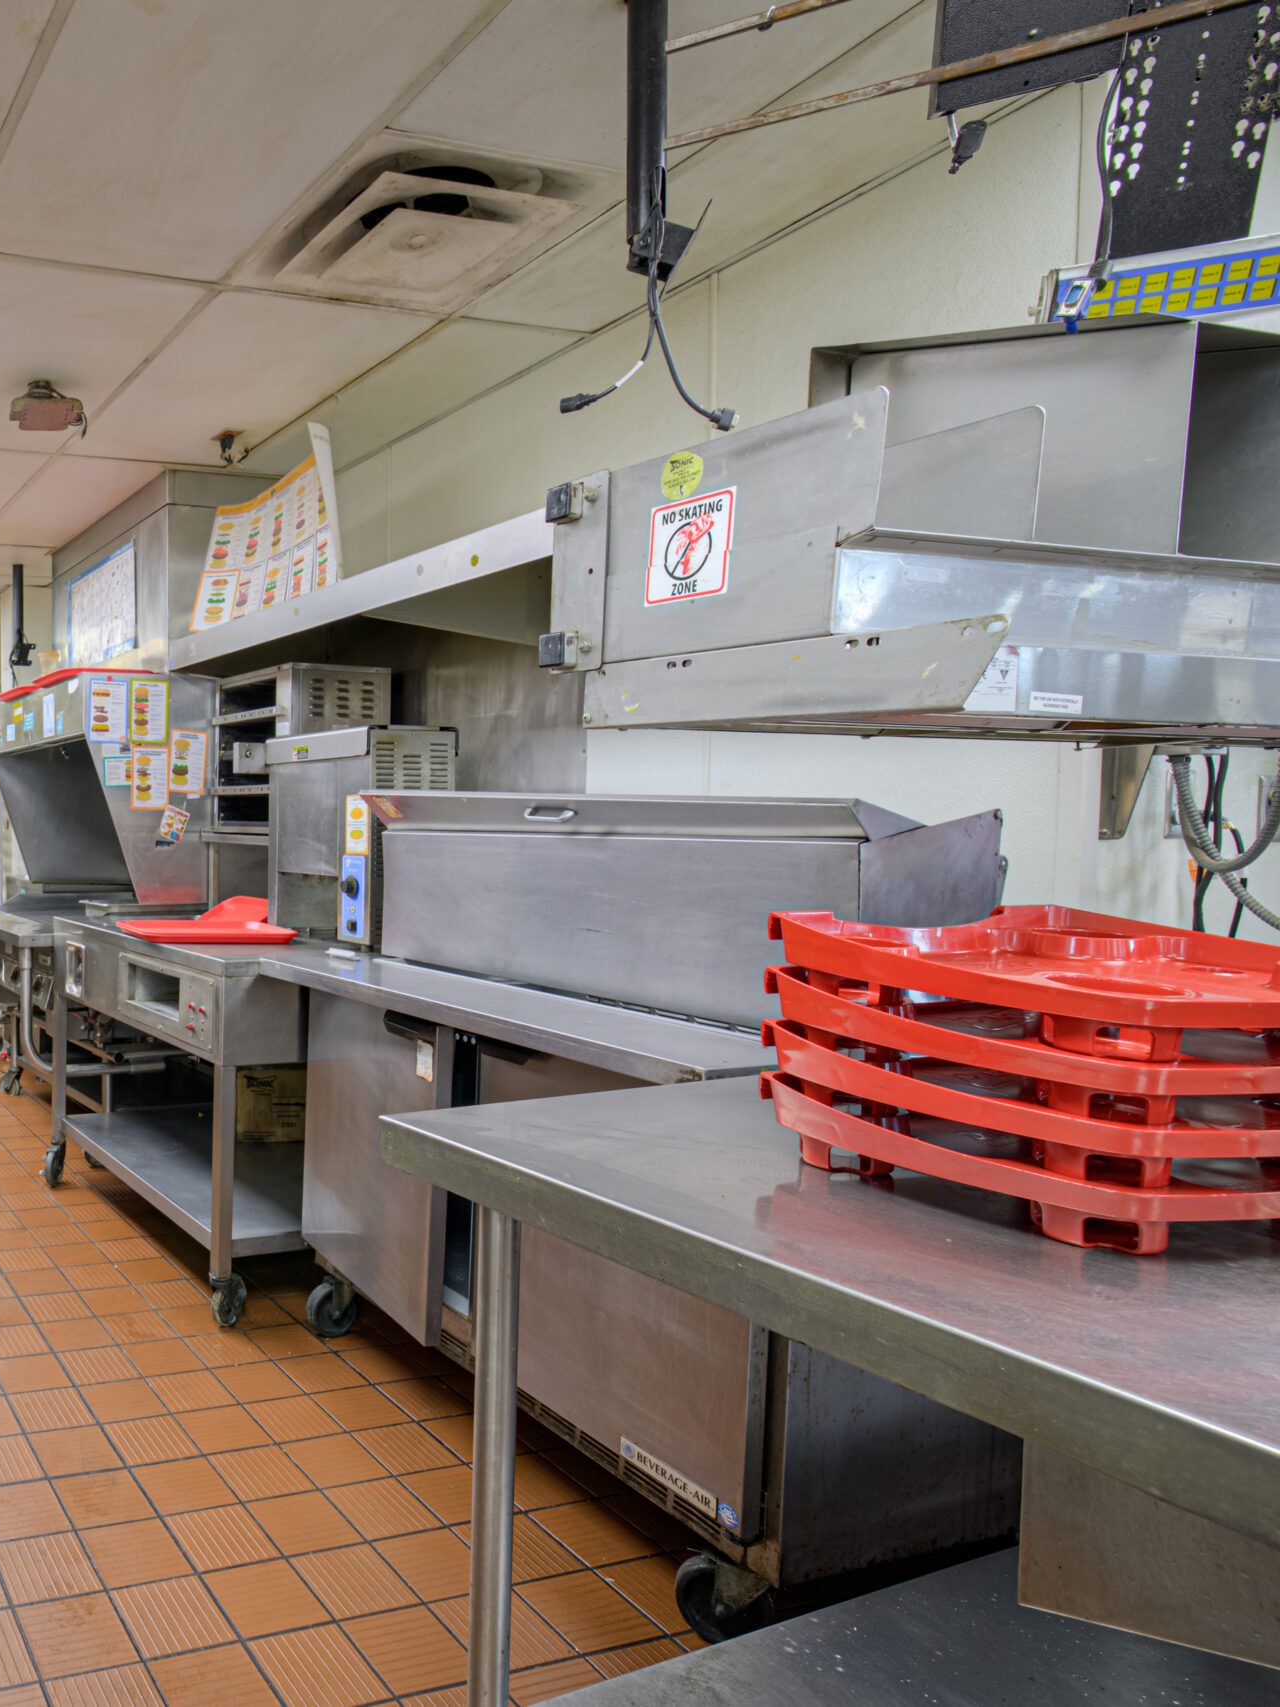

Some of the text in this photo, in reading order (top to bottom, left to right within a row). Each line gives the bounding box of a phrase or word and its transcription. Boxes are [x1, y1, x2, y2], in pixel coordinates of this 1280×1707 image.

[669, 456, 694, 473] SONIC
[662, 499, 723, 526] NO SKATING
[671, 580, 698, 597] ZONE
[637, 1452, 712, 1510] BEVERAGE-AIR
